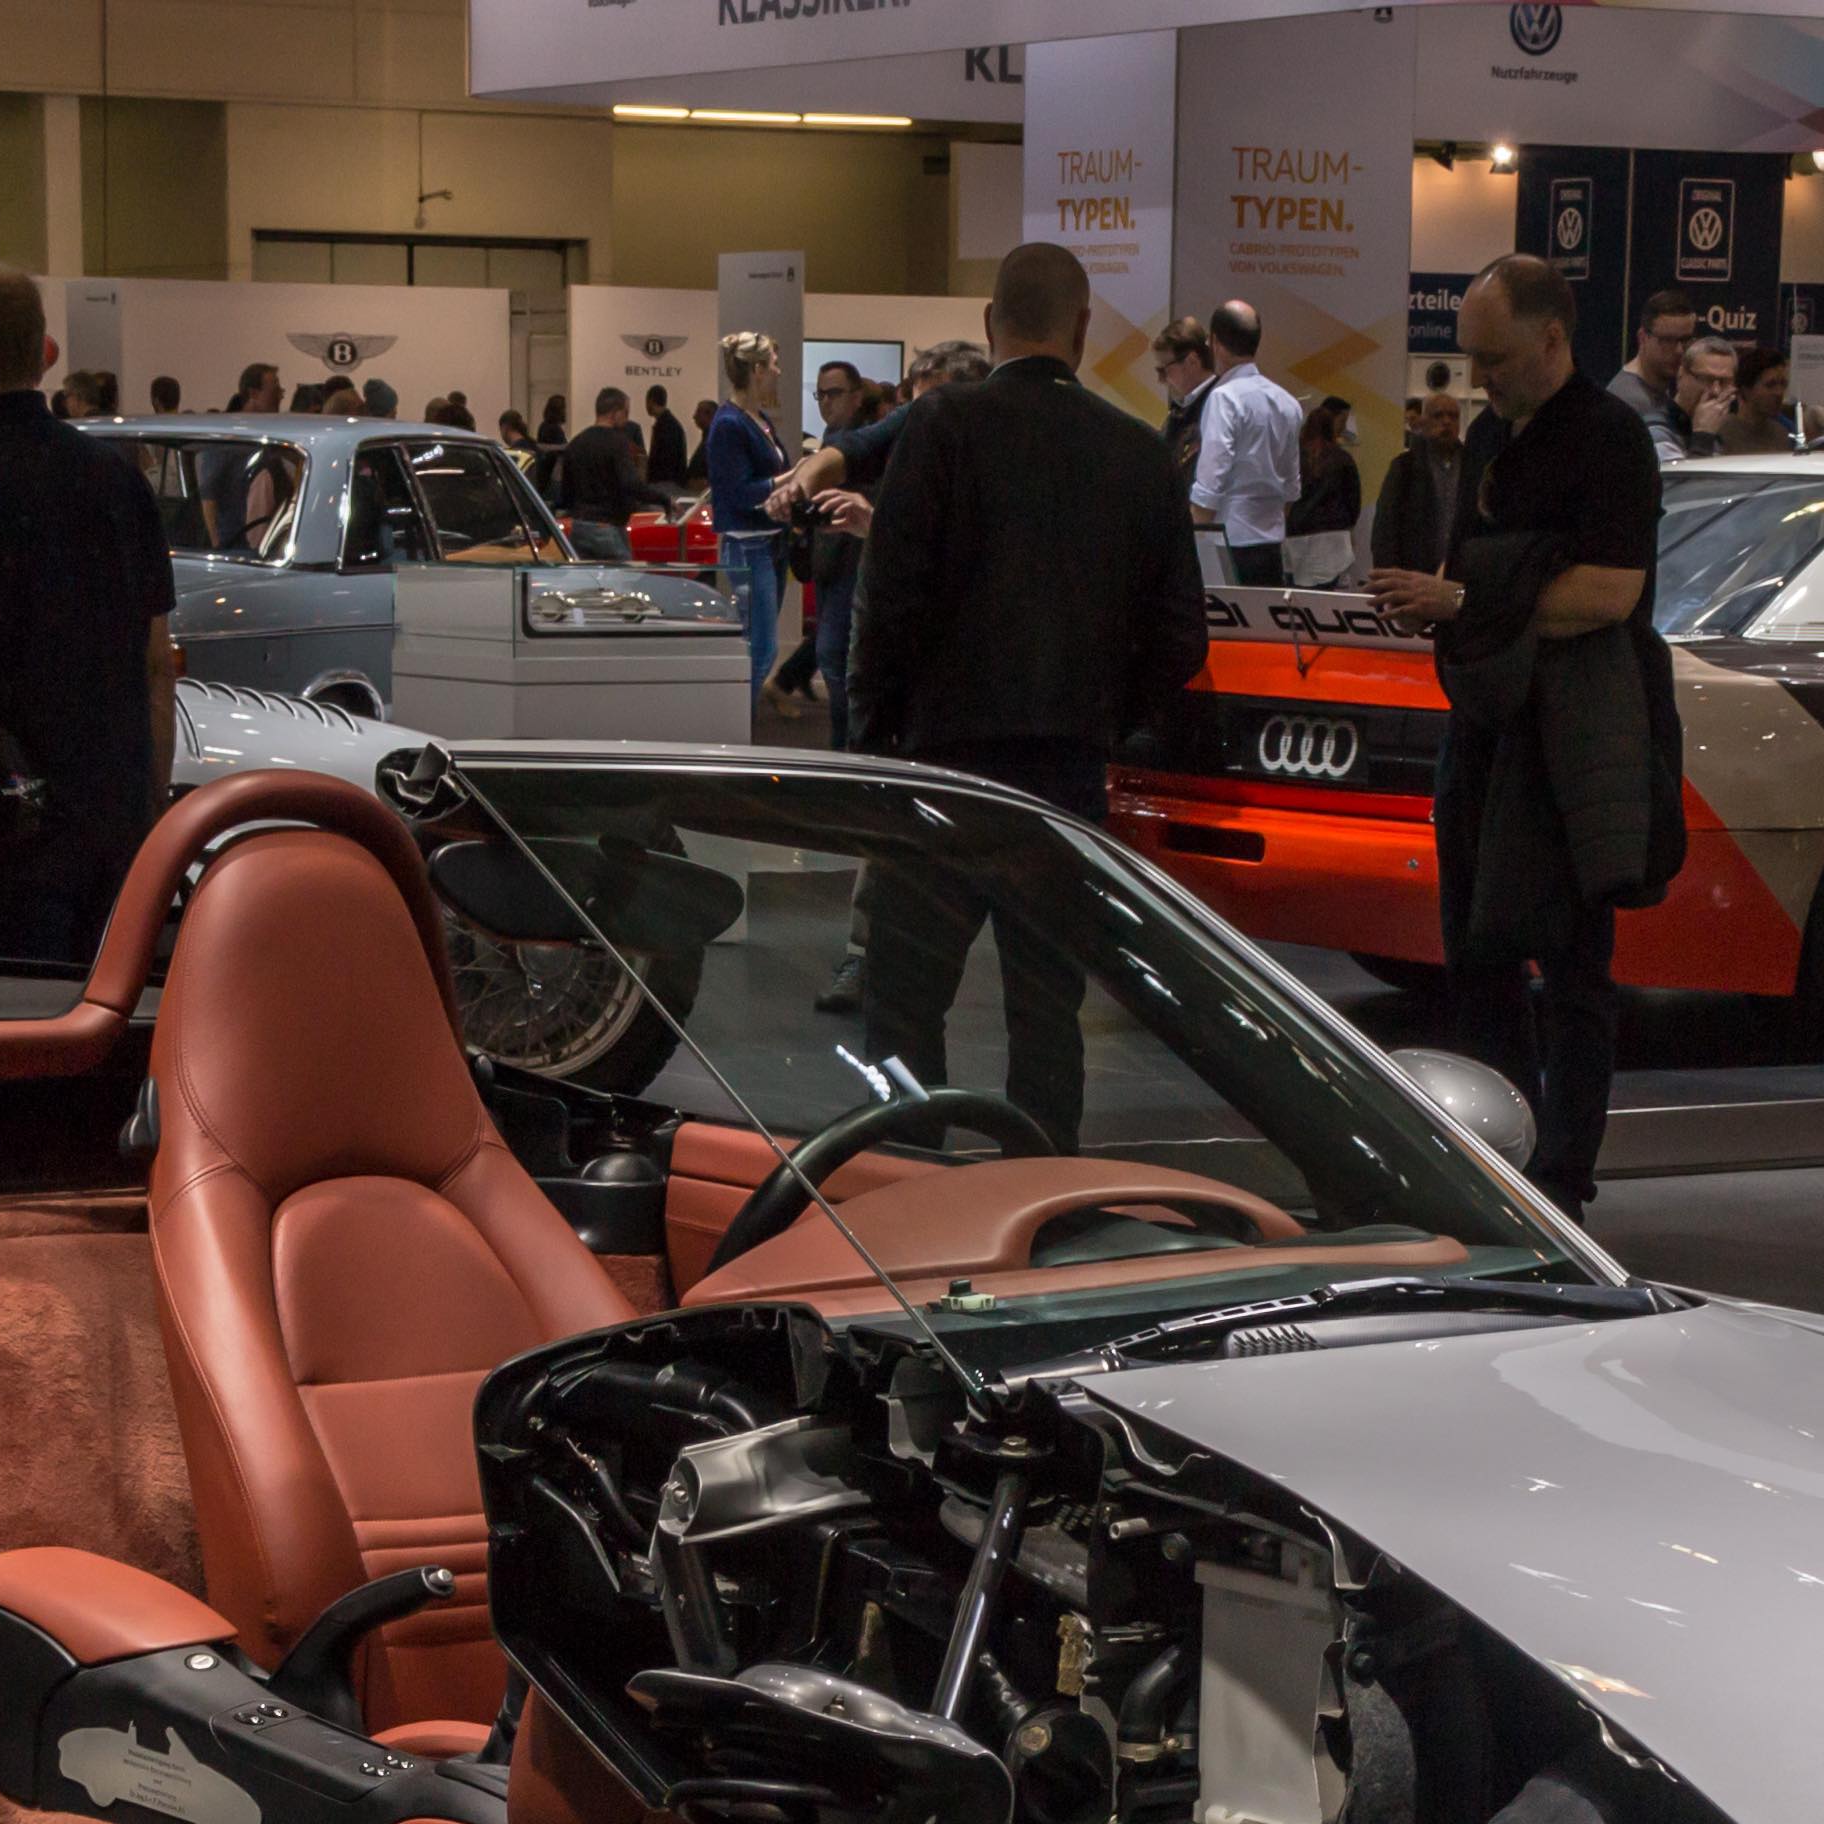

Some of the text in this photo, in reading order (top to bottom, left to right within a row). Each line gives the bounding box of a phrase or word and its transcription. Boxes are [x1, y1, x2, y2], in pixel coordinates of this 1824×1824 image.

[1491, 65, 1578, 84] Nutzfahrzeuge
[1057, 149, 1143, 184] TRAUM-
[1232, 147, 1364, 184] TRAUM-
[1057, 197, 1136, 231] TYPEN.
[1231, 195, 1354, 233] TYPEN.
[626, 365, 682, 377] BENTLEY
